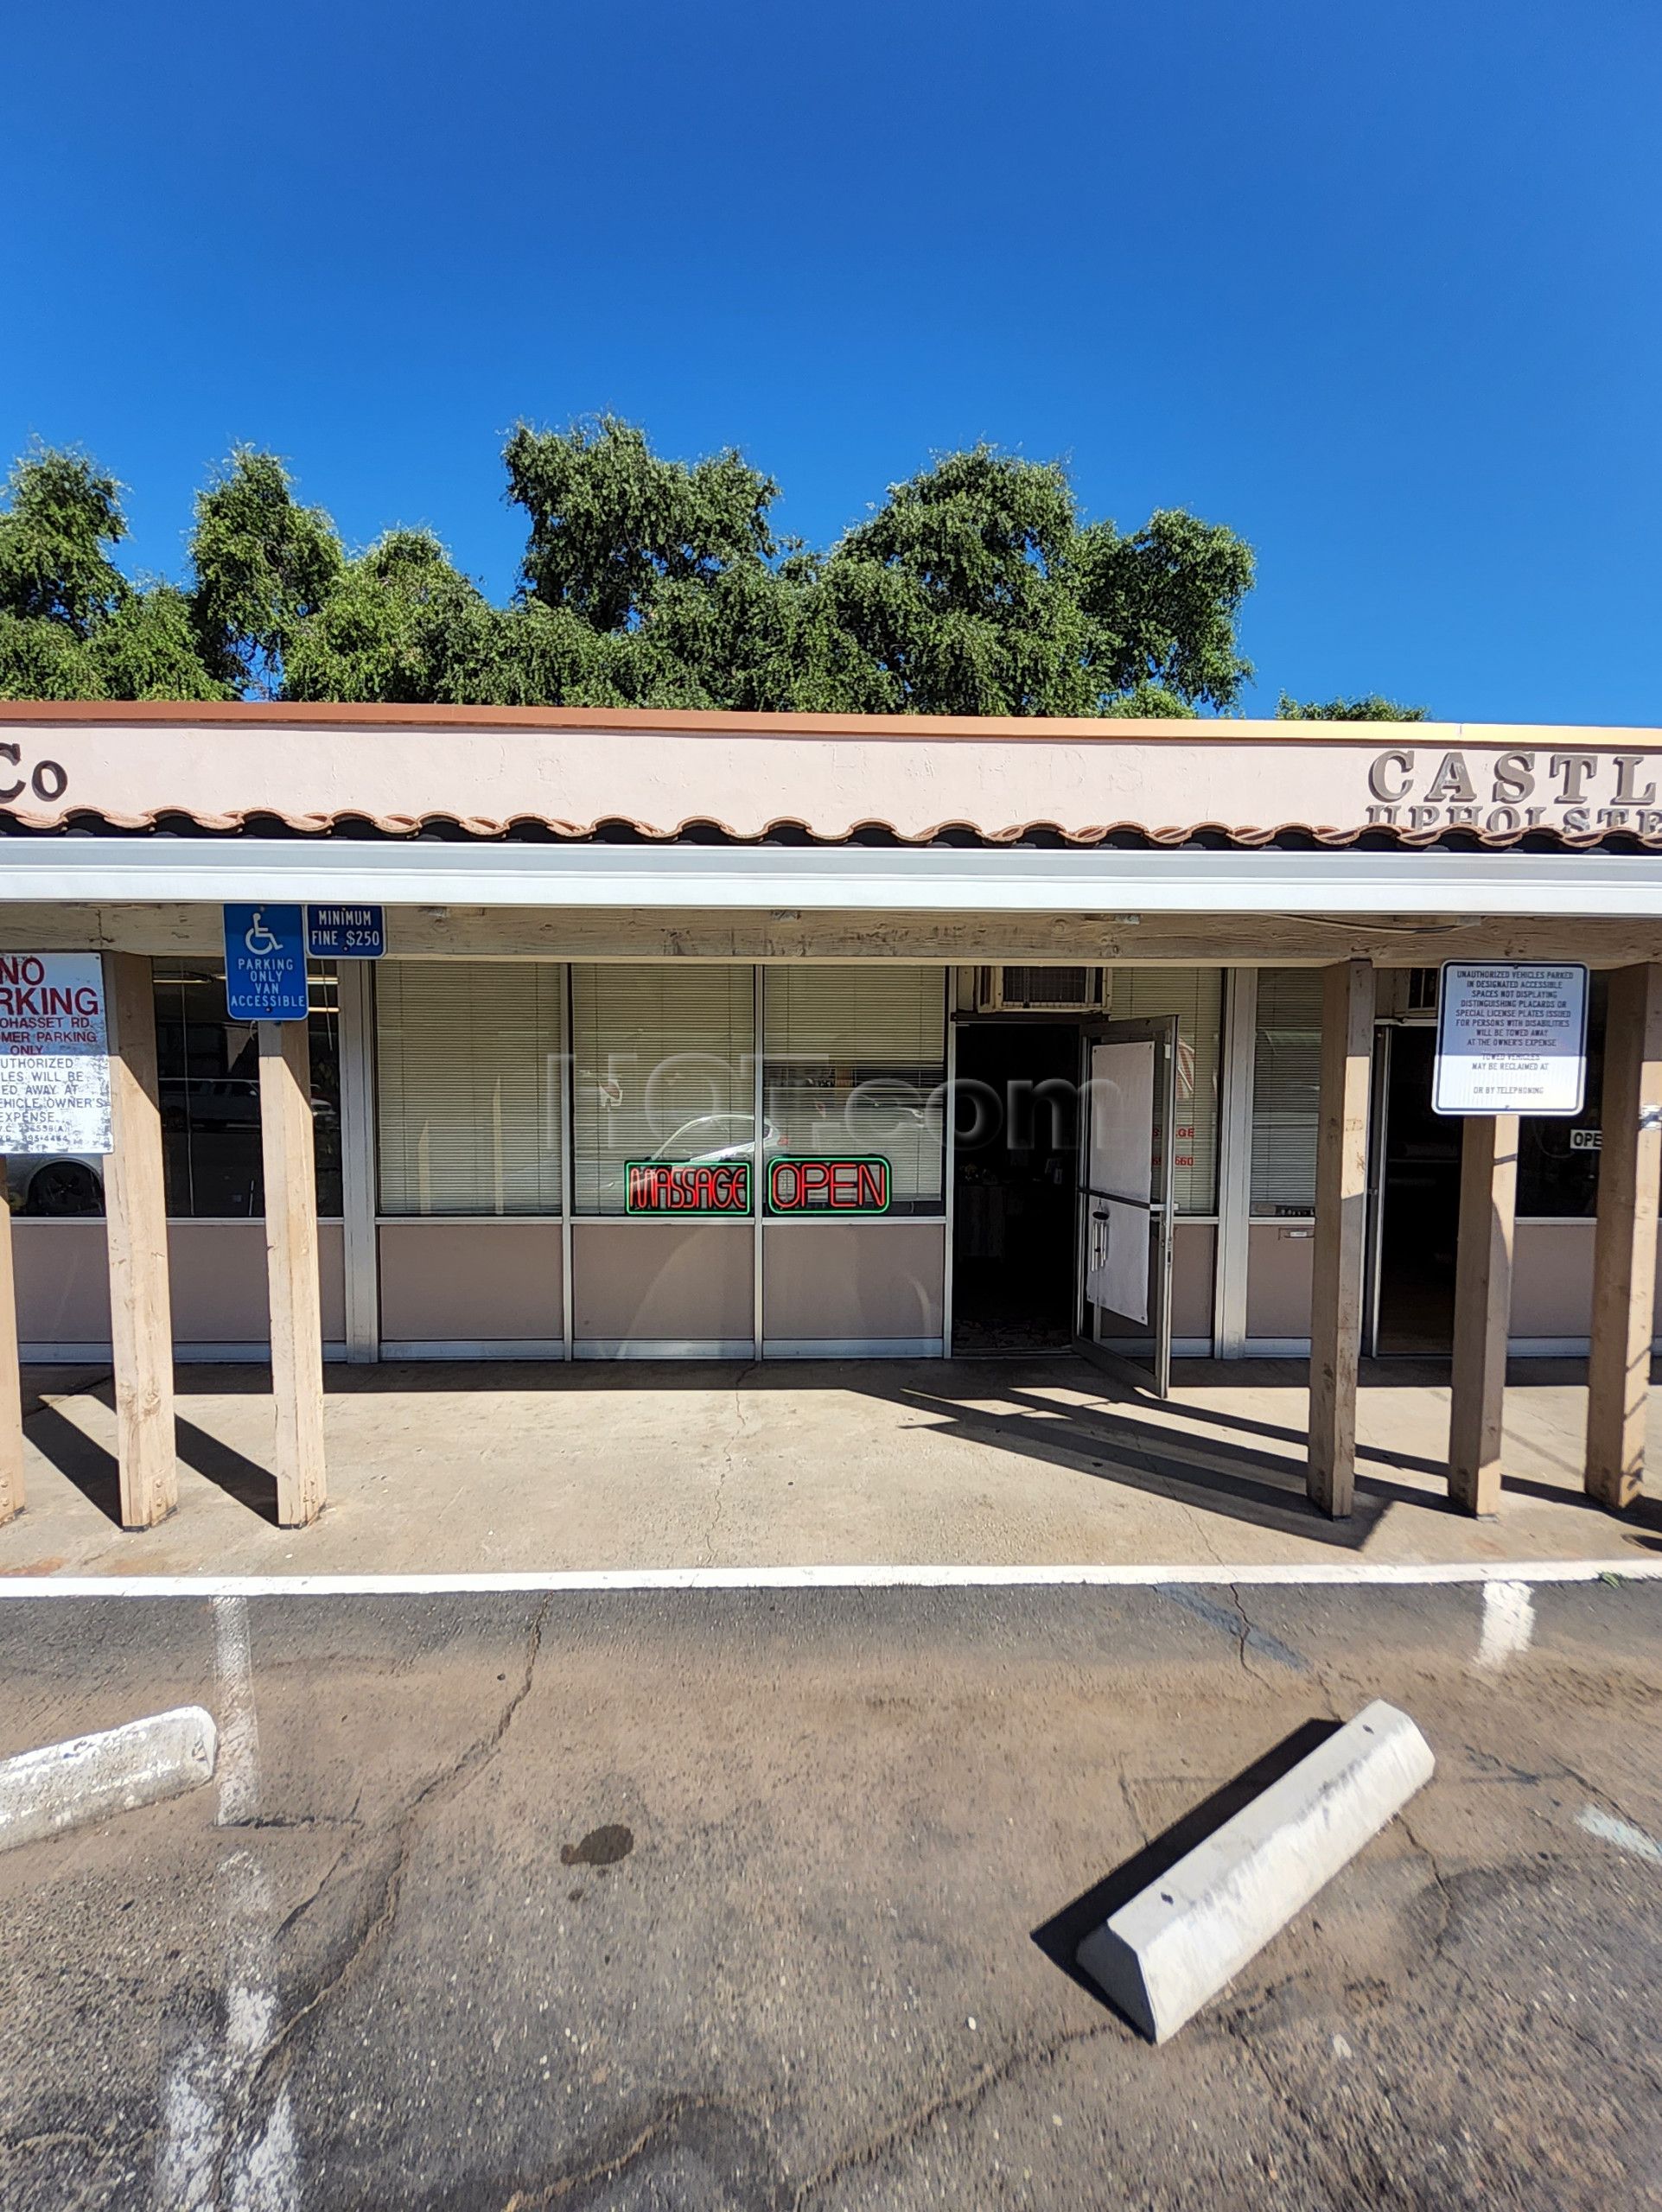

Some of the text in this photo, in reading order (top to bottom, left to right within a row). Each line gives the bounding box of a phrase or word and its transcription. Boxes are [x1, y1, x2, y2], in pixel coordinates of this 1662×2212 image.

[1368, 749, 1657, 806] CASTL
[319, 910, 372, 926] MINIMUM
[312, 930, 380, 947] FINE $250
[238, 958, 294, 970] PARKING
[0, 956, 45, 986] NO
[251, 970, 283, 982] ONLY
[1456, 970, 1574, 979] UNAUTHORIZED VEHICLES PARKED
[255, 982, 279, 995] VAN
[231, 995, 305, 1007] ACCESSIBLE
[1461, 1000, 1567, 1008] DISTINGUISHING PLACARDS OR
[1455, 1009, 1571, 1018] SPECIAL LICENSE PLATES ISSUED
[1456, 1019, 1570, 1027] FOR PERSONS WITH DISABILITIES
[36, 1031, 98, 1042] PARKING
[10, 1045, 44, 1056] ONLY
[0, 1058, 74, 1069] UTHORIZED
[31, 1071, 61, 1082] WILL
[68, 1071, 84, 1082] BE
[25, 1084, 58, 1095] AWAY
[65, 1084, 80, 1095] AT
[47, 1097, 104, 1108] OWNER'S
[1574, 1132, 1602, 1147] OPE
[629, 1168, 748, 1209] MASSAGE
[772, 1163, 886, 1209] OPEN
